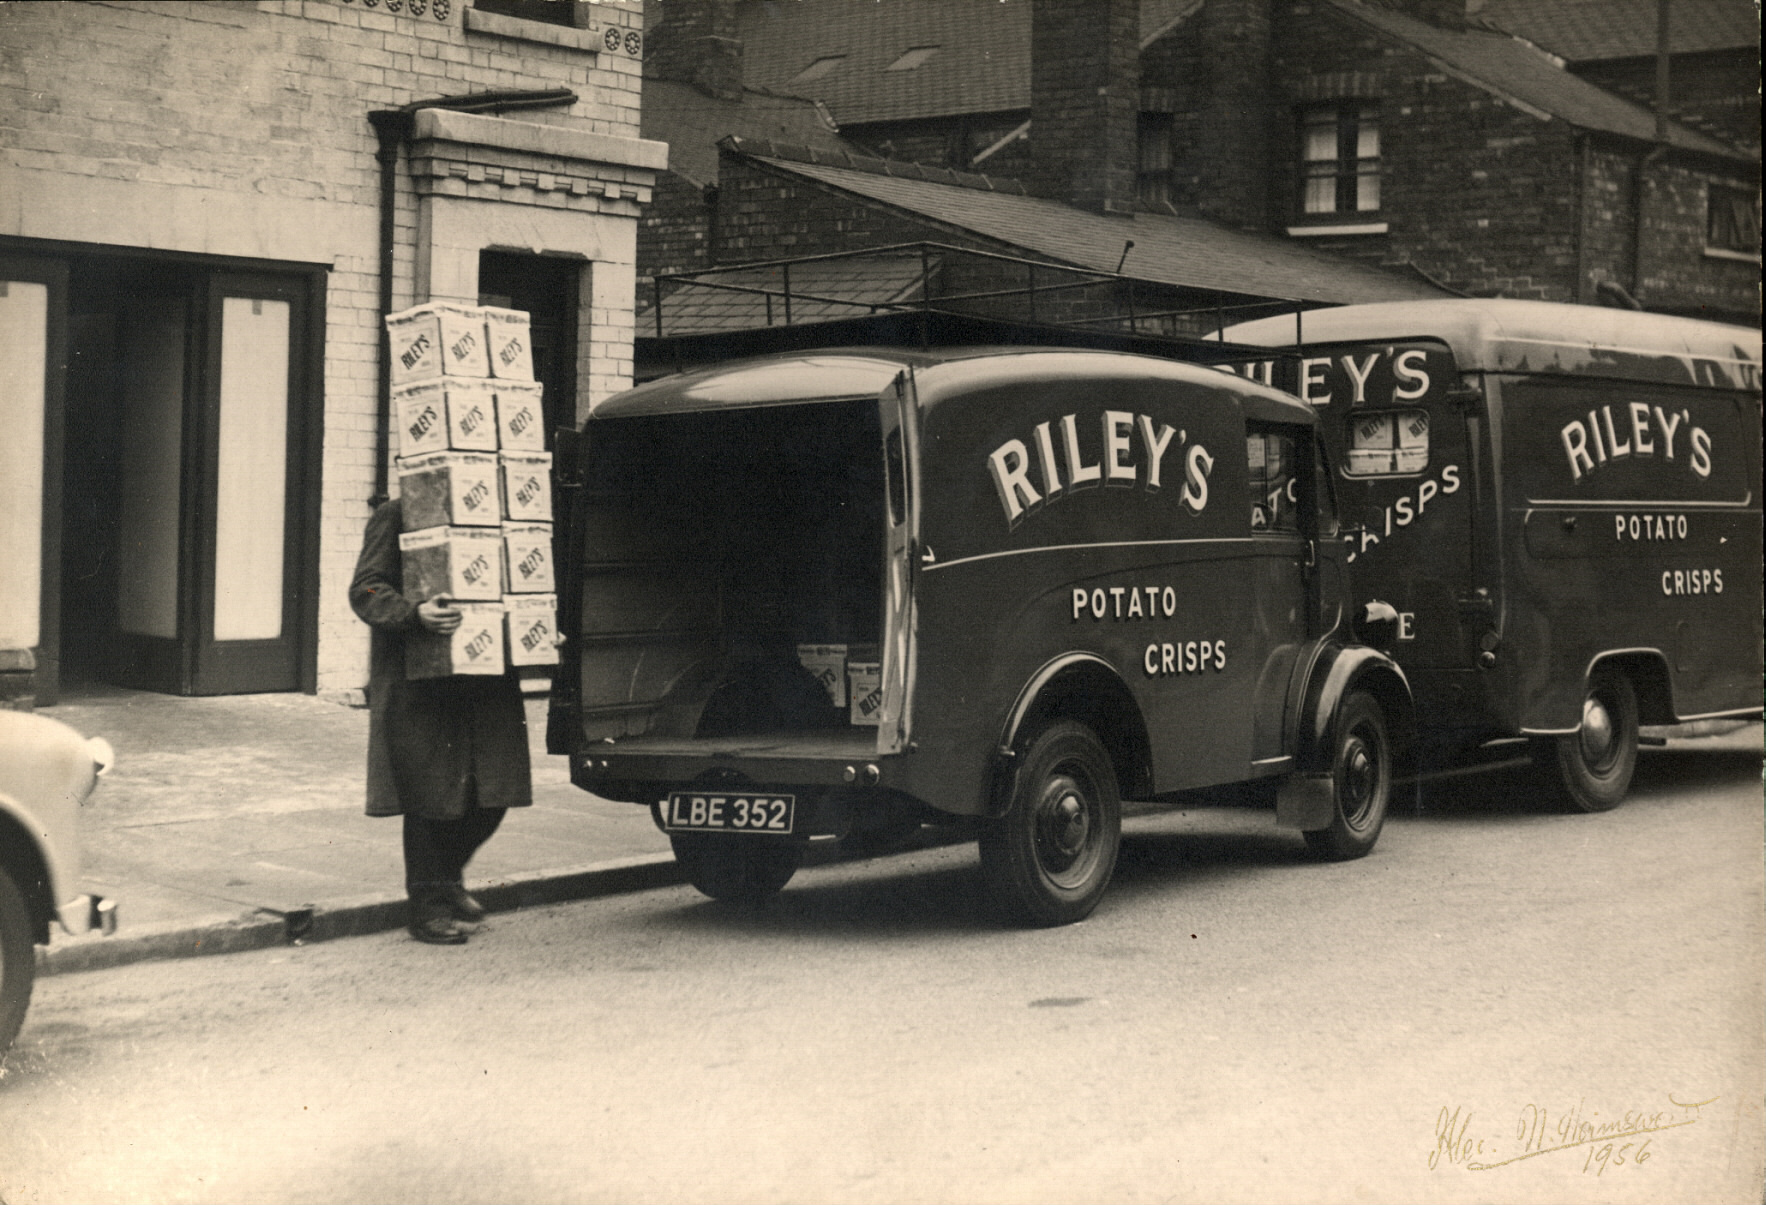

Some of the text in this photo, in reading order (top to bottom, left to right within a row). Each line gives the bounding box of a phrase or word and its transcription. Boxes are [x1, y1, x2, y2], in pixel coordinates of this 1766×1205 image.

[1213, 346, 1430, 405] EY'S
[1560, 401, 1712, 480] RILEY'S
[987, 410, 1215, 532] RILEY'S
[1615, 515, 1688, 540] POTATO
[1662, 568, 1724, 596] CRISPS
[1072, 586, 1177, 620] POTATO
[1144, 639, 1227, 675] CRISPS
[671, 796, 787, 829] LBE 352
[1582, 1138, 1653, 1178] 1956
